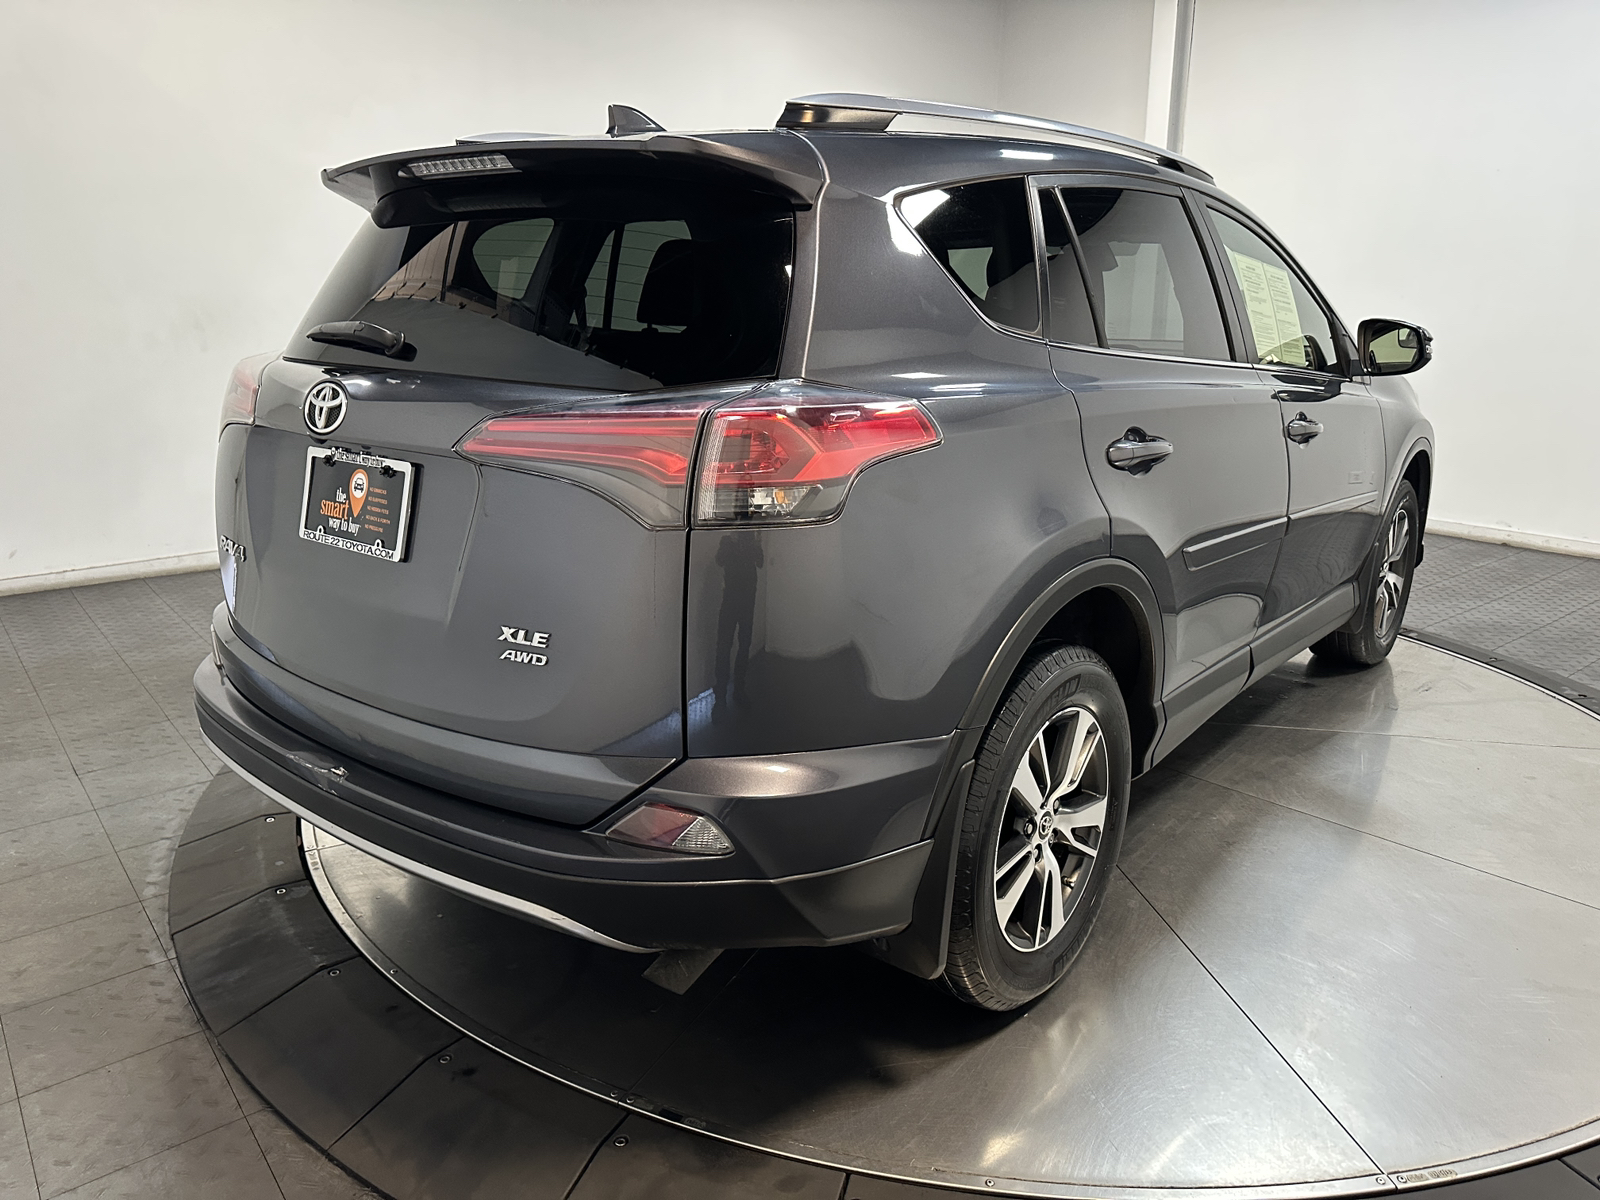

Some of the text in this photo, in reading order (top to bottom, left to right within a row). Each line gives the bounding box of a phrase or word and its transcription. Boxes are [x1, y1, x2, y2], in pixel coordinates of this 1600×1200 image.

[336, 487, 347, 503] the
[320, 499, 349, 520] smart
[328, 517, 360, 537] way to buy
[219, 534, 246, 563] RAV4
[497, 625, 551, 649] XLE
[499, 649, 549, 667] AWD
